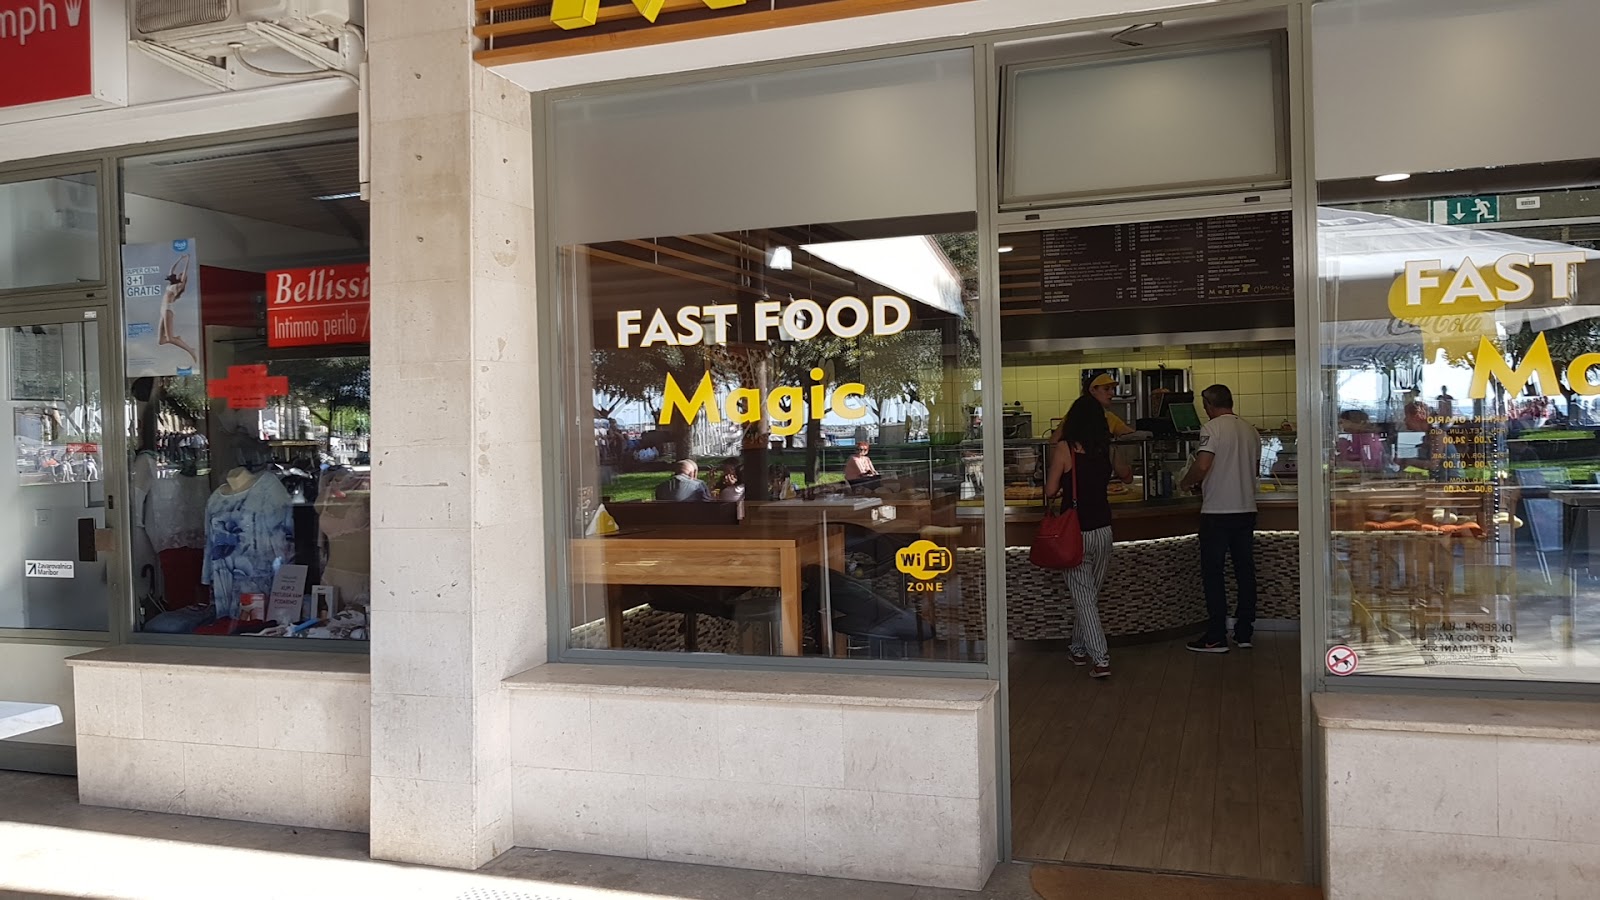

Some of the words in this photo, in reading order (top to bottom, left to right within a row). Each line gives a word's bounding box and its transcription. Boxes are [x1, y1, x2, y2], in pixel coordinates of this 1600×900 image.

[126, 267, 143, 275] SUPER
[126, 276, 143, 286] 3+1
[274, 266, 370, 304] Bellissi
[1404, 251, 1586, 306] FAST
[127, 285, 160, 297] GRATIS
[274, 316, 319, 339] Intimno
[323, 309, 356, 342] perilo
[616, 303, 738, 349] FAST
[754, 295, 911, 342] FOOD
[658, 367, 866, 436] Magic
[906, 582, 943, 592] ZONE
